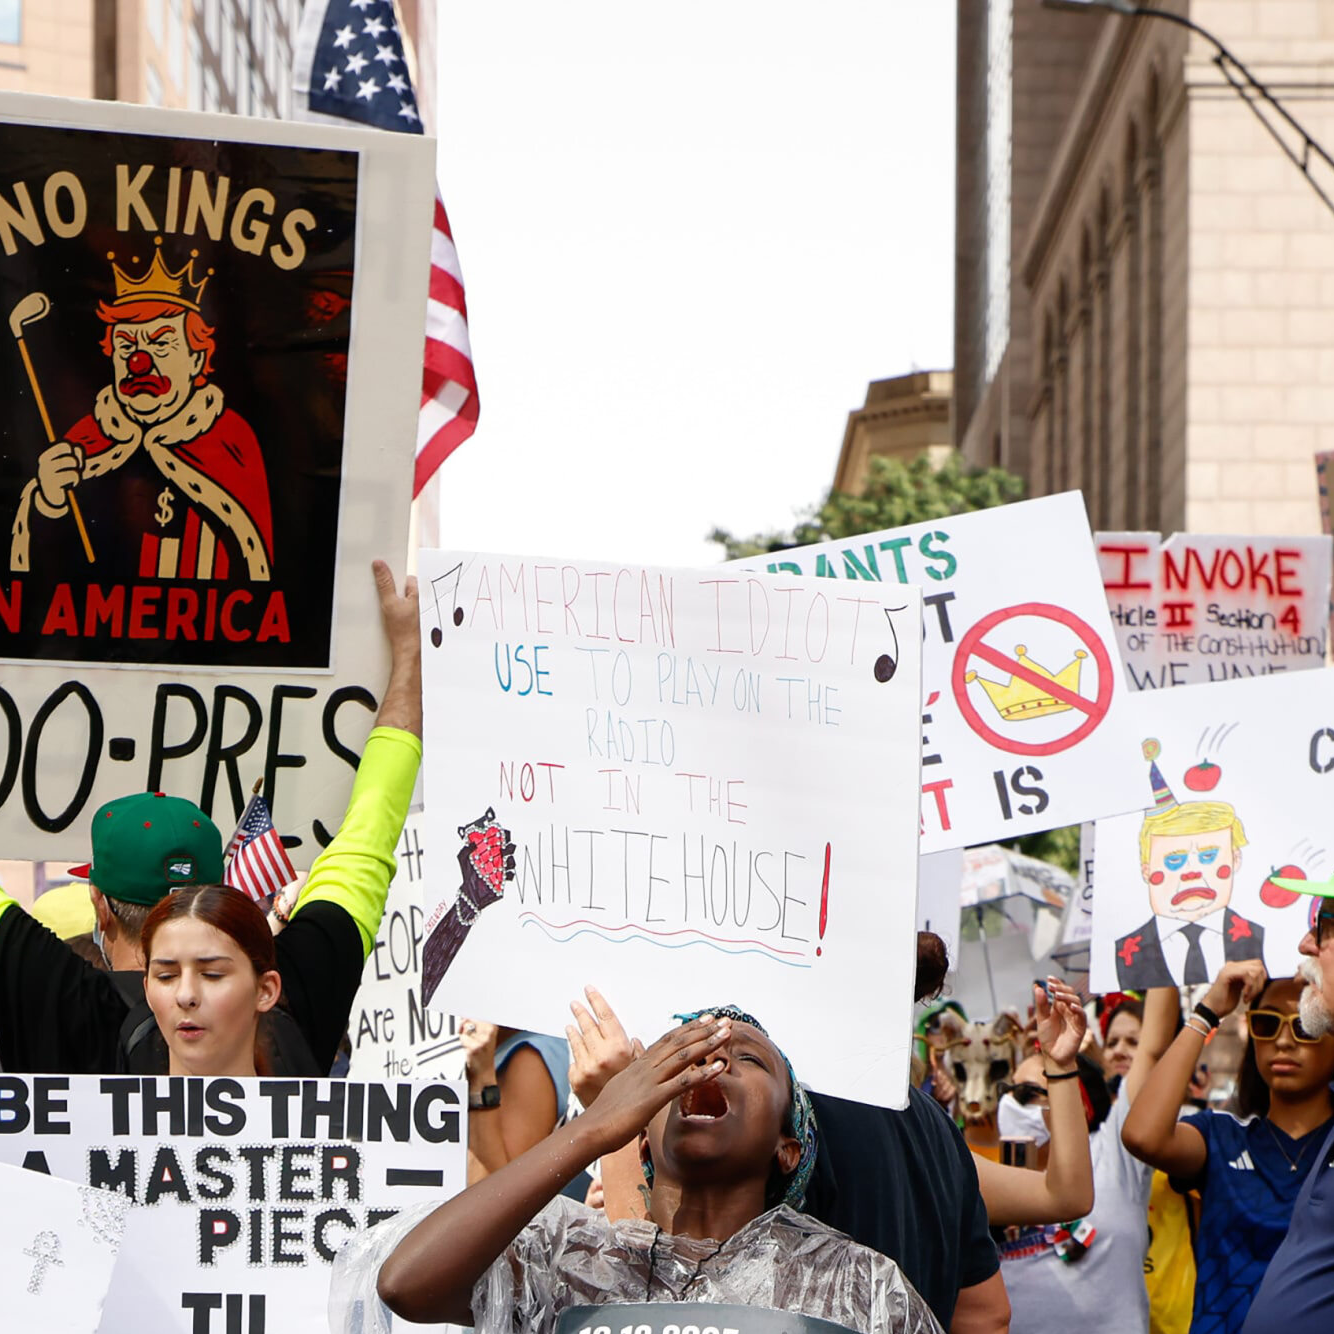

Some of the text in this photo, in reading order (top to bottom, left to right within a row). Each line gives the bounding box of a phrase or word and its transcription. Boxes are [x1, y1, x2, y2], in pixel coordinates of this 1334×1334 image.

[114, 163, 317, 271] KINGS
[41, 583, 291, 643] AMERICA
[469, 563, 676, 648] AMERICAN
[699, 579, 880, 665] IDIOT
[1110, 602, 1300, 634] rticle II Section 4
[1127, 633, 1154, 652] OF
[1162, 633, 1195, 653] THE
[495, 641, 842, 726] USE TO PLAY ON THE
[1127, 662, 1189, 690] WE
[586, 707, 675, 767] RADIO
[499, 762, 748, 824] NOT IN THE
[993, 765, 1050, 820] IS
[357, 1008, 394, 1049] Are
[383, 1050, 413, 1078] the
[100, 1077, 248, 1137] THIS
[269, 1080, 461, 1143] THING
